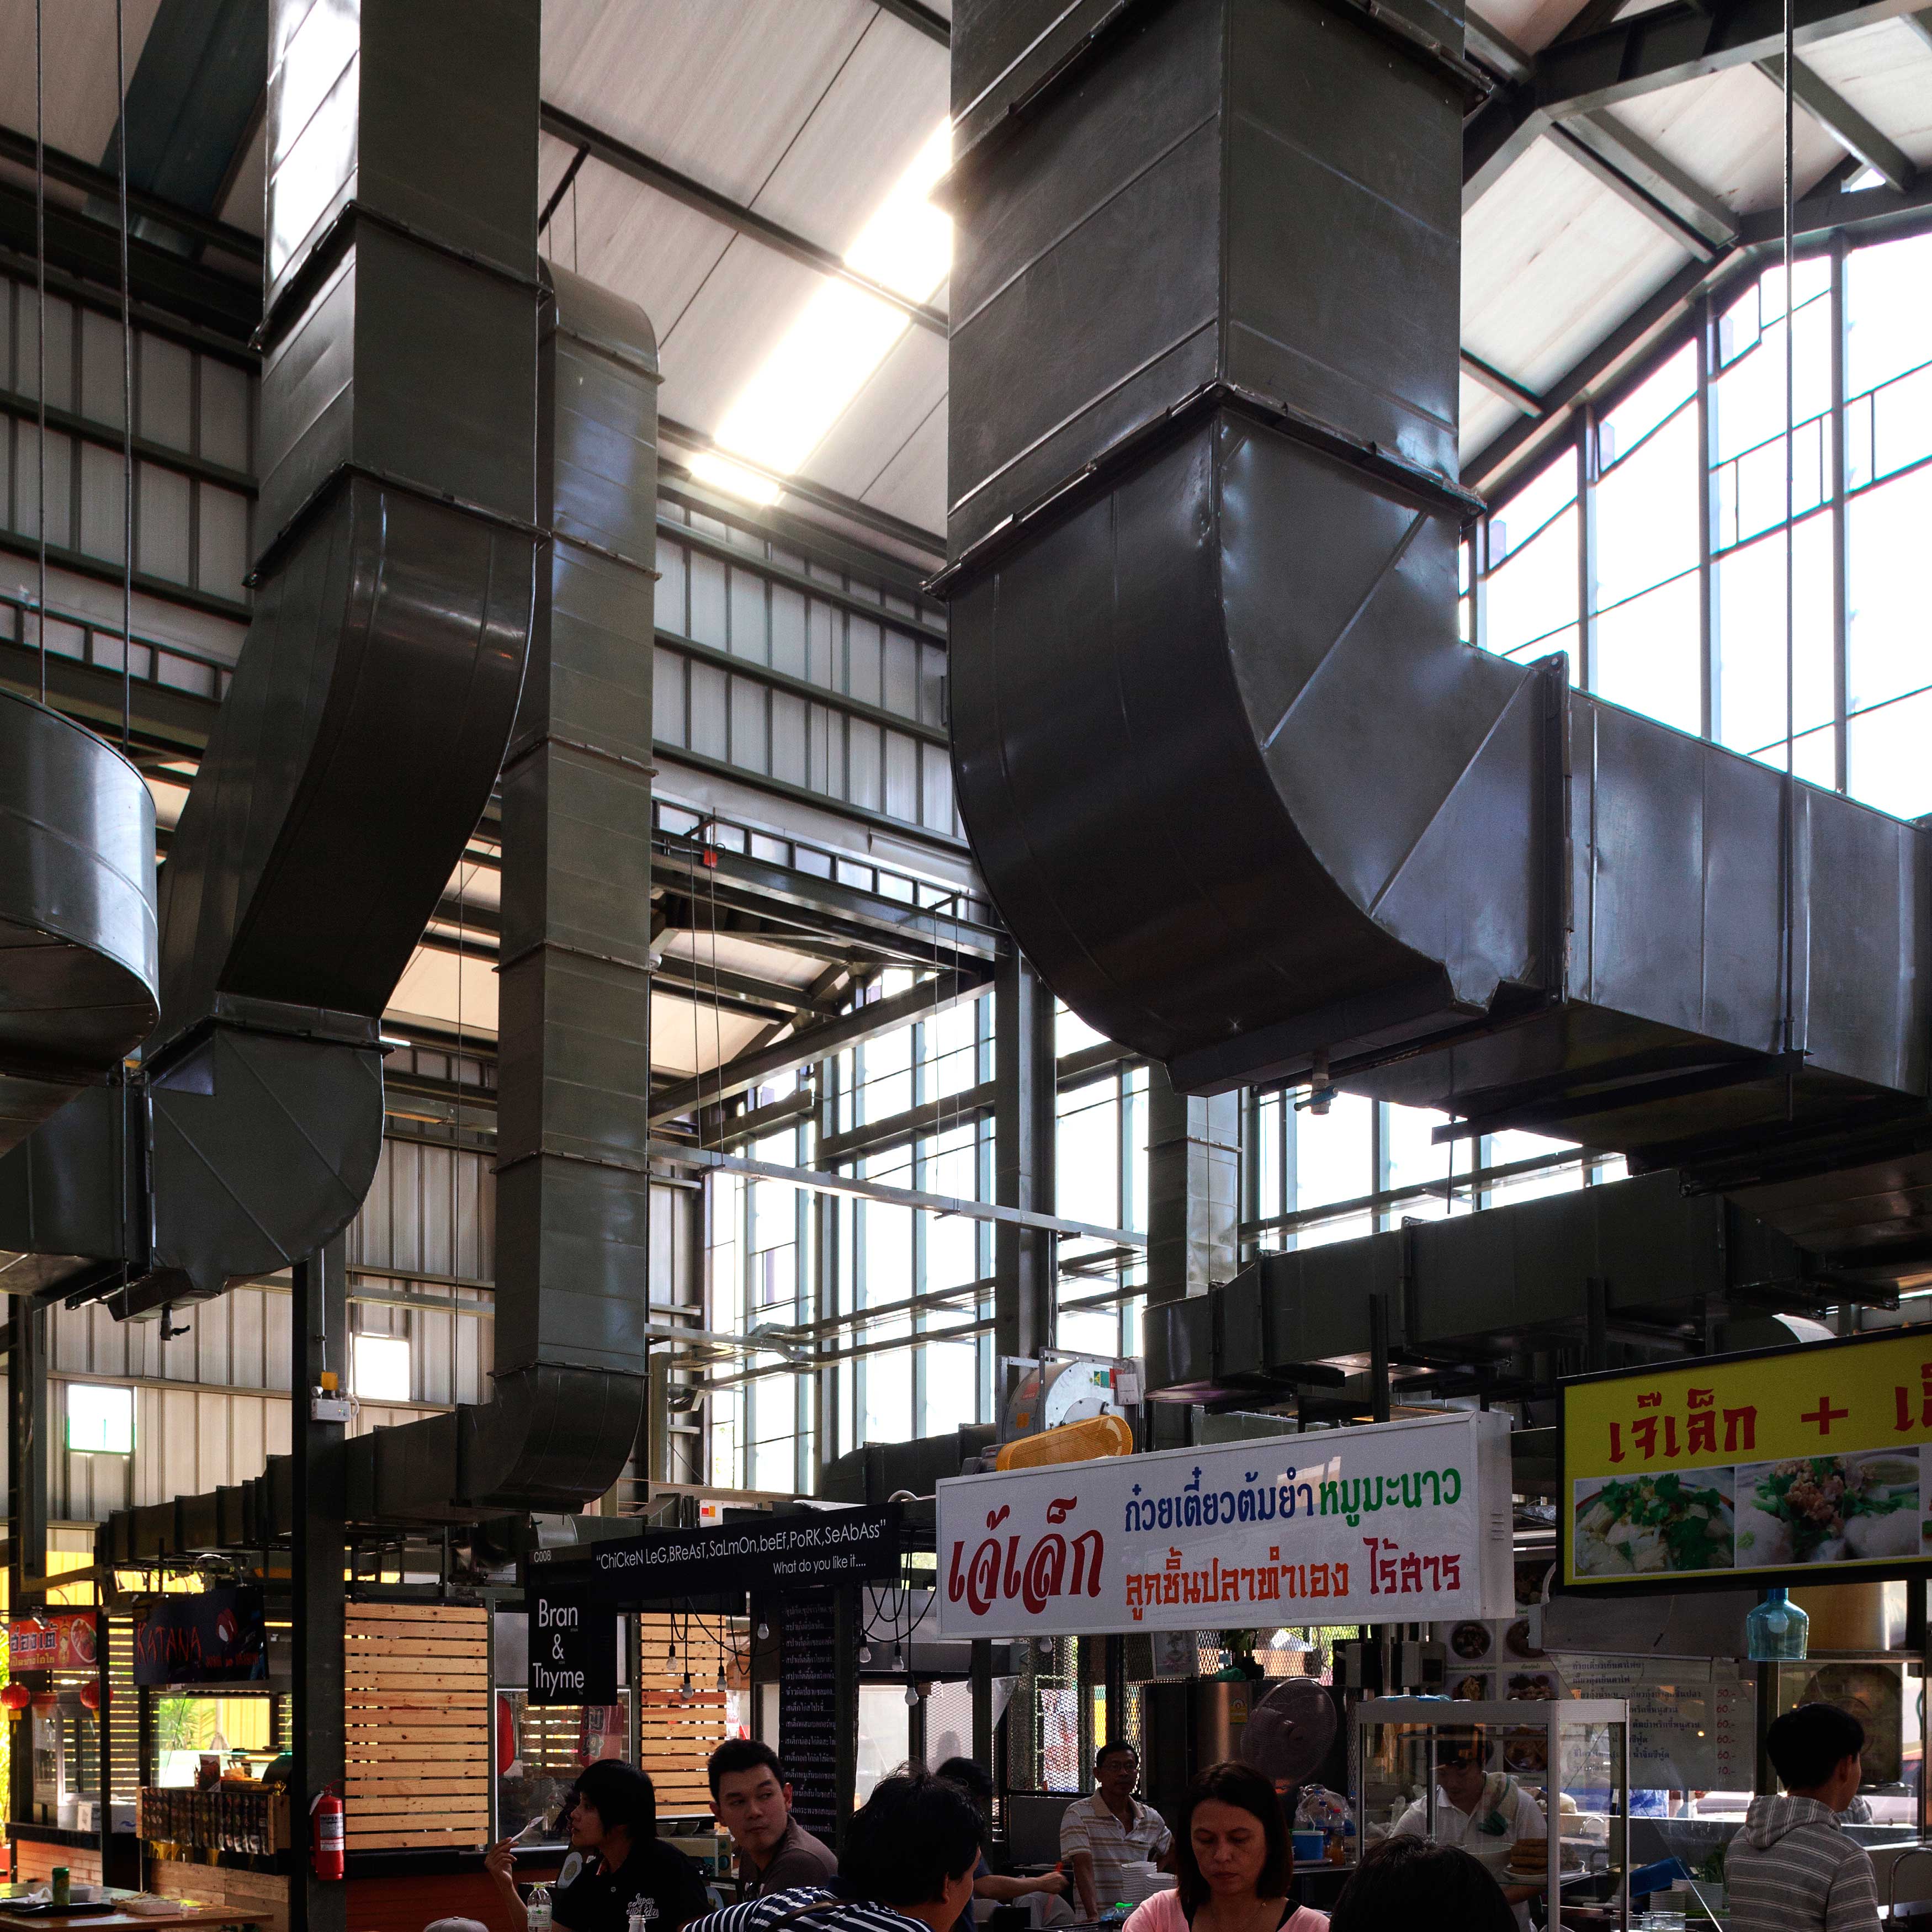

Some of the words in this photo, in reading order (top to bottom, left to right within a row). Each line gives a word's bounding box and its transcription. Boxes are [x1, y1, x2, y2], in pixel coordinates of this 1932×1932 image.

[534, 1550, 551, 1563] C008
[773, 1560, 797, 1574] What
[799, 1559, 811, 1572] do
[813, 1560, 830, 1573] you
[833, 1556, 848, 1569] like
[948, 1496, 1104, 1616] เจ้เล็ก
[1126, 1546, 1349, 1621] ลูกชิ้นปลาทำเอง
[1363, 1537, 1461, 1595] ไร้สาร
[539, 1599, 578, 1627] Bran
[137, 1622, 202, 1665] KATANA
[552, 1633, 564, 1659] &
[532, 1663, 584, 1697] Thyme
[1717, 1705, 1735, 1713] 60.-
[1717, 1719, 1735, 1728] 60.-
[1717, 1735, 1736, 1744] 60.-
[1717, 1750, 1736, 1760] 60.-
